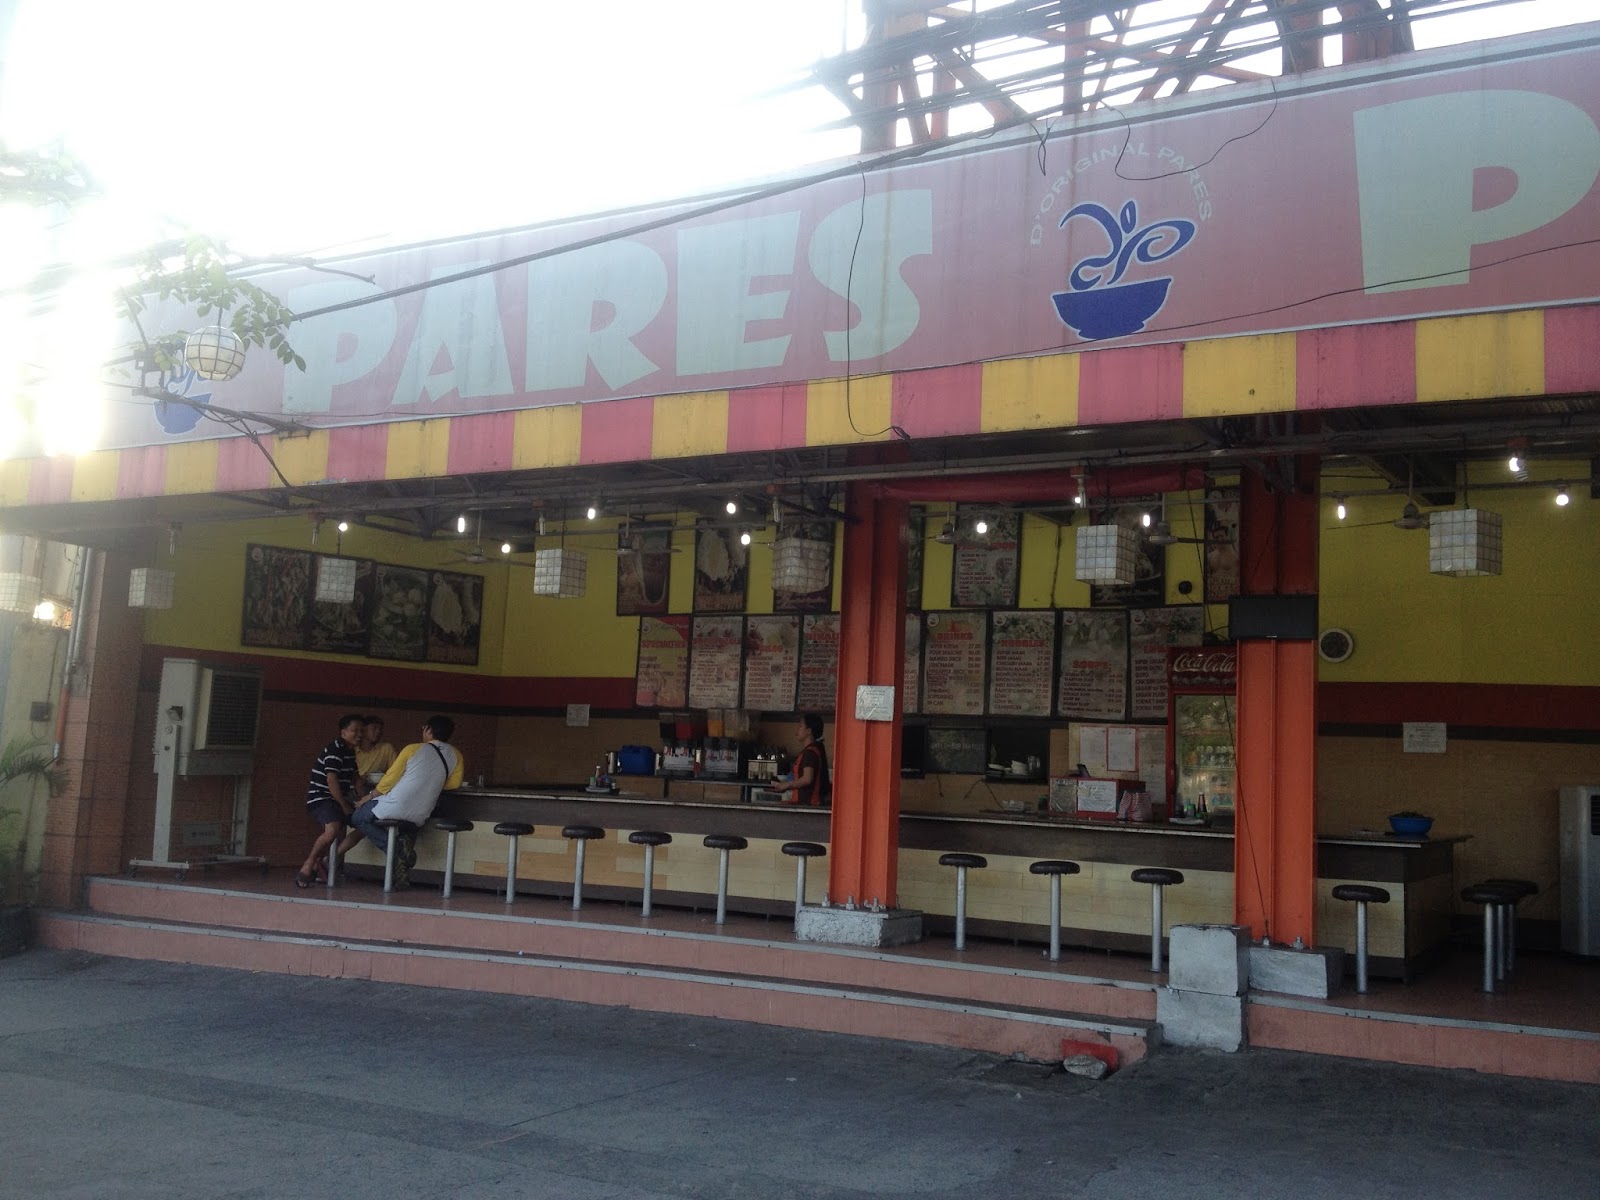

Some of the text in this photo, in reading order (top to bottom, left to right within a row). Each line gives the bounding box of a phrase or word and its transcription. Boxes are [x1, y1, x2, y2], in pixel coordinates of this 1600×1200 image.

[1157, 145, 1212, 222] PARES
[282, 188, 933, 415] PARES
[936, 632, 974, 640] DRINKS
